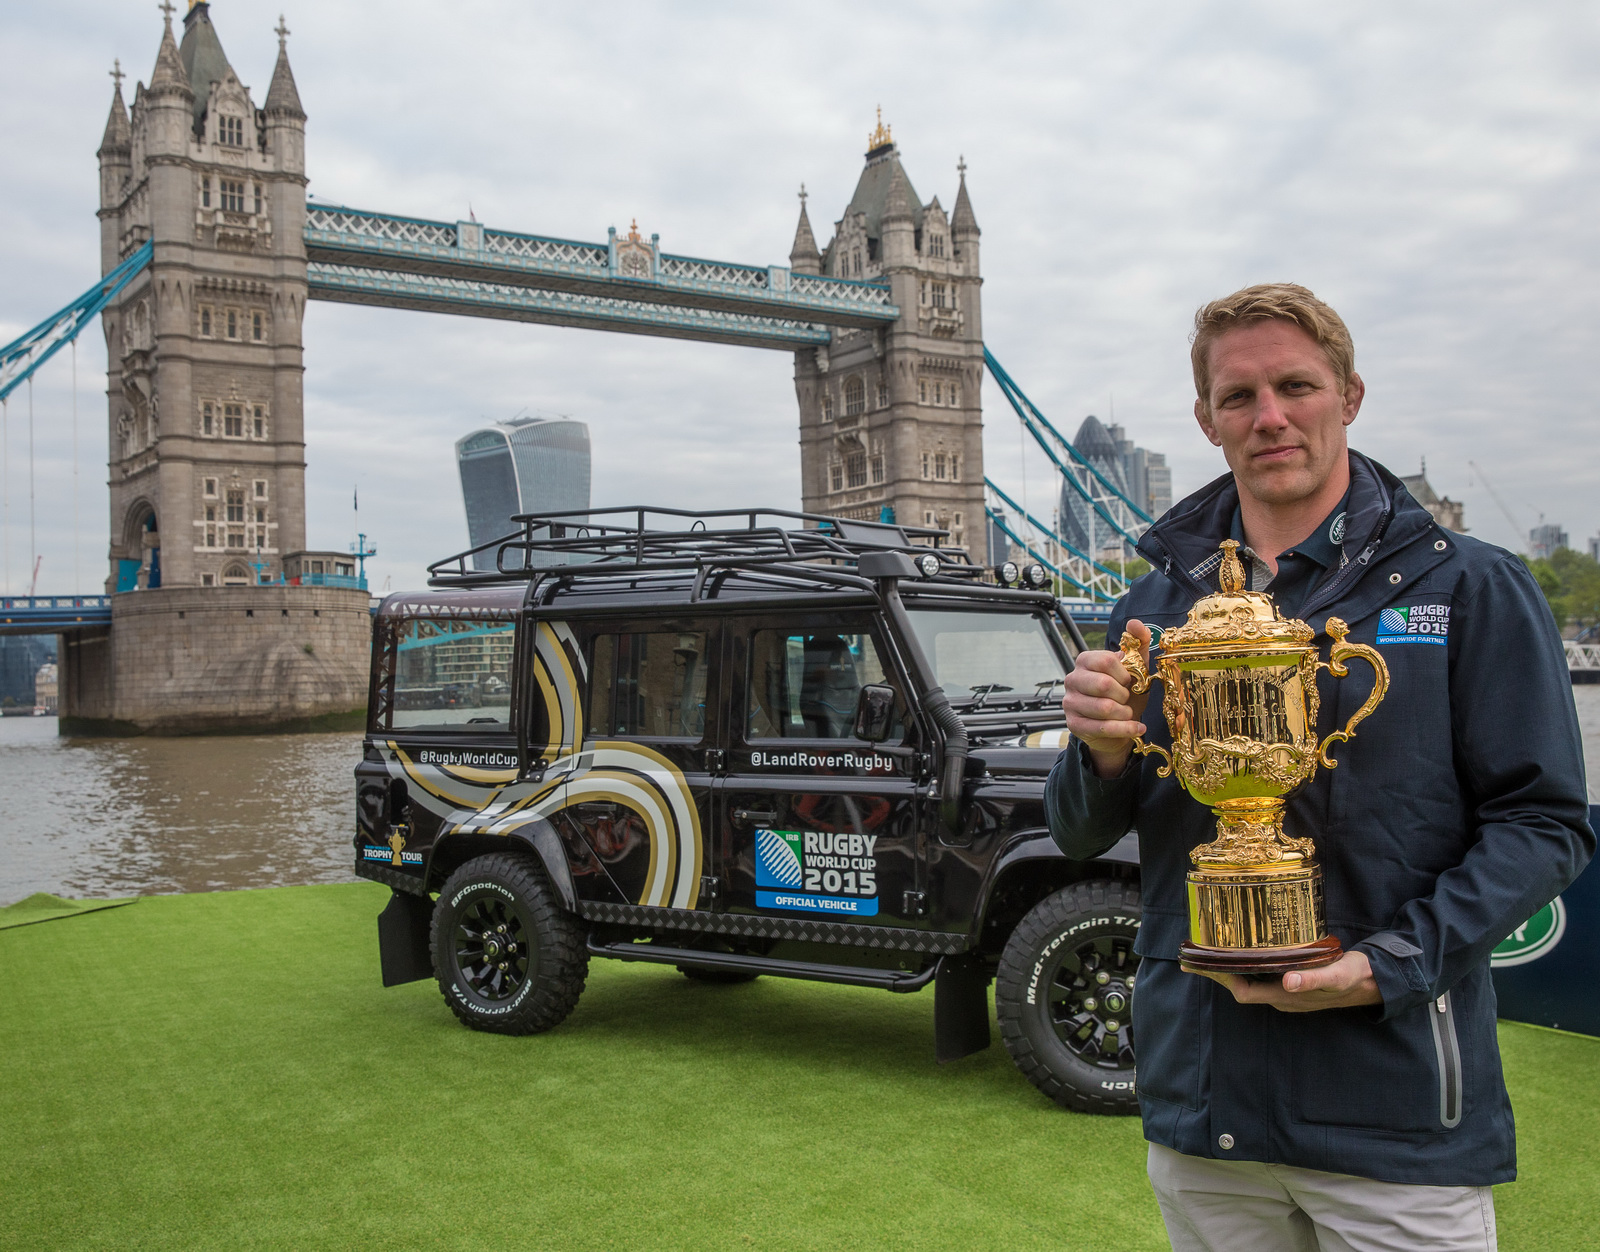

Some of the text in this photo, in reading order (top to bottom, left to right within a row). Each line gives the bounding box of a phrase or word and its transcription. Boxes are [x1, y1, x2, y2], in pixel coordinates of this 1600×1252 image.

[1409, 604, 1451, 617] RUGBY
[1409, 615, 1450, 624] WORLD CUP
[1407, 622, 1449, 636] 2015
[420, 751, 518, 767] @RugbyWorldCup
[751, 752, 893, 771] @LandRoverRugby
[785, 833, 799, 842] IRB
[804, 832, 878, 857] RUGBY
[363, 848, 423, 862] TROPHY TOUR
[805, 855, 877, 870] WORLD CUP
[804, 868, 877, 895] 2015
[451, 882, 515, 907] BFGoodrich
[775, 896, 858, 911] OFFICIAL VEHICLE
[1027, 917, 1110, 1005] Mud-Terrain
[468, 979, 532, 1015] Mud-Terrain
